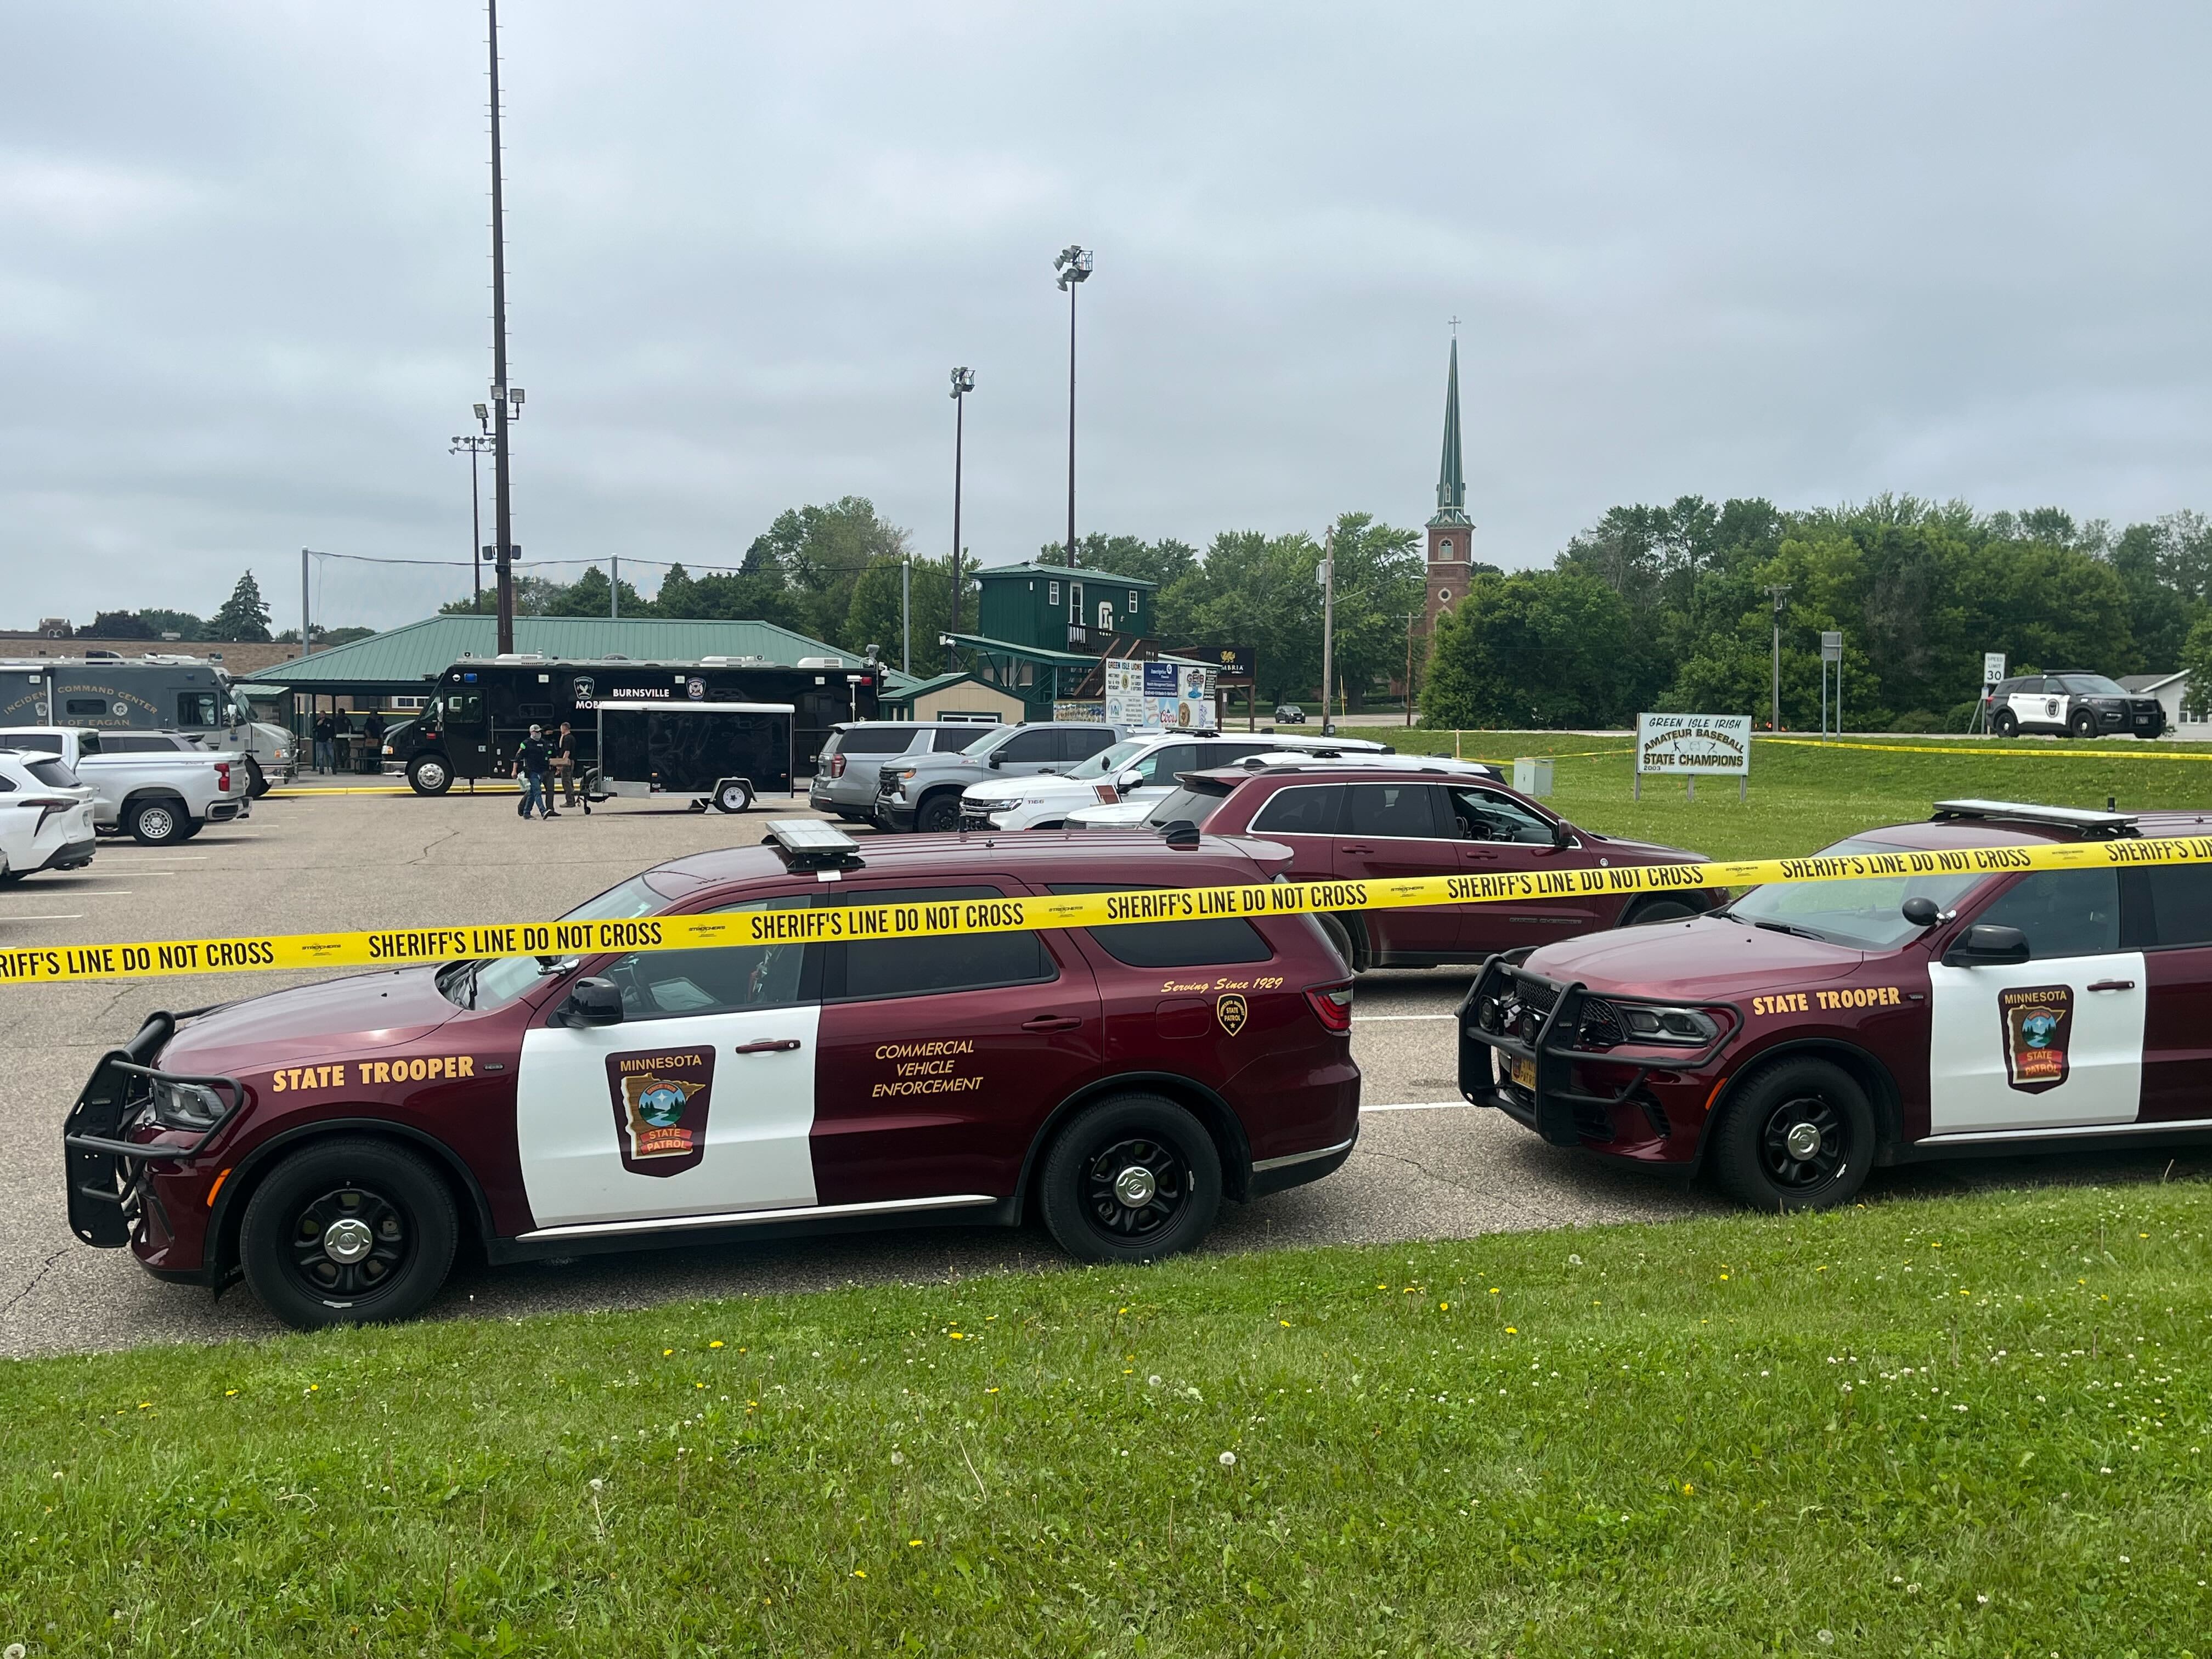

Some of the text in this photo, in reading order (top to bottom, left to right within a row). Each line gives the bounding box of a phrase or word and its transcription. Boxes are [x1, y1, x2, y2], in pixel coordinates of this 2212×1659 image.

[1987, 670, 2001, 680] 30
[4, 685, 157, 715] INCIDEN COMMAND CENTER
[613, 689, 669, 697] BURNSVILLE
[1649, 718, 1742, 729] GREEN ISLE IRISH
[1644, 729, 1744, 754] AMATEUR BASEBALL
[1644, 753, 1744, 766] STATE CHAMPIONS
[2106, 842, 2188, 861] SHERIFF'S
[1781, 850, 2030, 878] SHERIFF'S LINE DO NOT CROSS
[1448, 867, 1703, 898] SHERIFF'S LINE DO NOT CROSS
[1108, 884, 1367, 919] SHERIFF'S LINE DO NOT CROSS
[752, 904, 1023, 939] SHERIFF'S LINE DO NOT CROSS
[369, 922, 662, 957] SHERIFF'S LINE DO NOT CROSS
[0, 942, 273, 977] RIFF'S LINE DO NOT CROSS
[1161, 977, 1283, 994] Serving Since 1929
[1753, 987, 1901, 1015] STATE TROOPER
[2005, 991, 2067, 1004] MINNESOTA
[876, 1040, 974, 1059] COMMERCIAL
[2027, 1051, 2052, 1061] STATE
[620, 1054, 702, 1071] MINNESOTA
[897, 1060, 955, 1077] VEHICLE
[2025, 1063, 2059, 1075] PATROL
[273, 1056, 475, 1092] STATE TROOPER
[872, 1077, 984, 1097] ENFORCEMENT
[649, 1128, 681, 1139] STATE
[647, 1139, 685, 1152] PATROL
